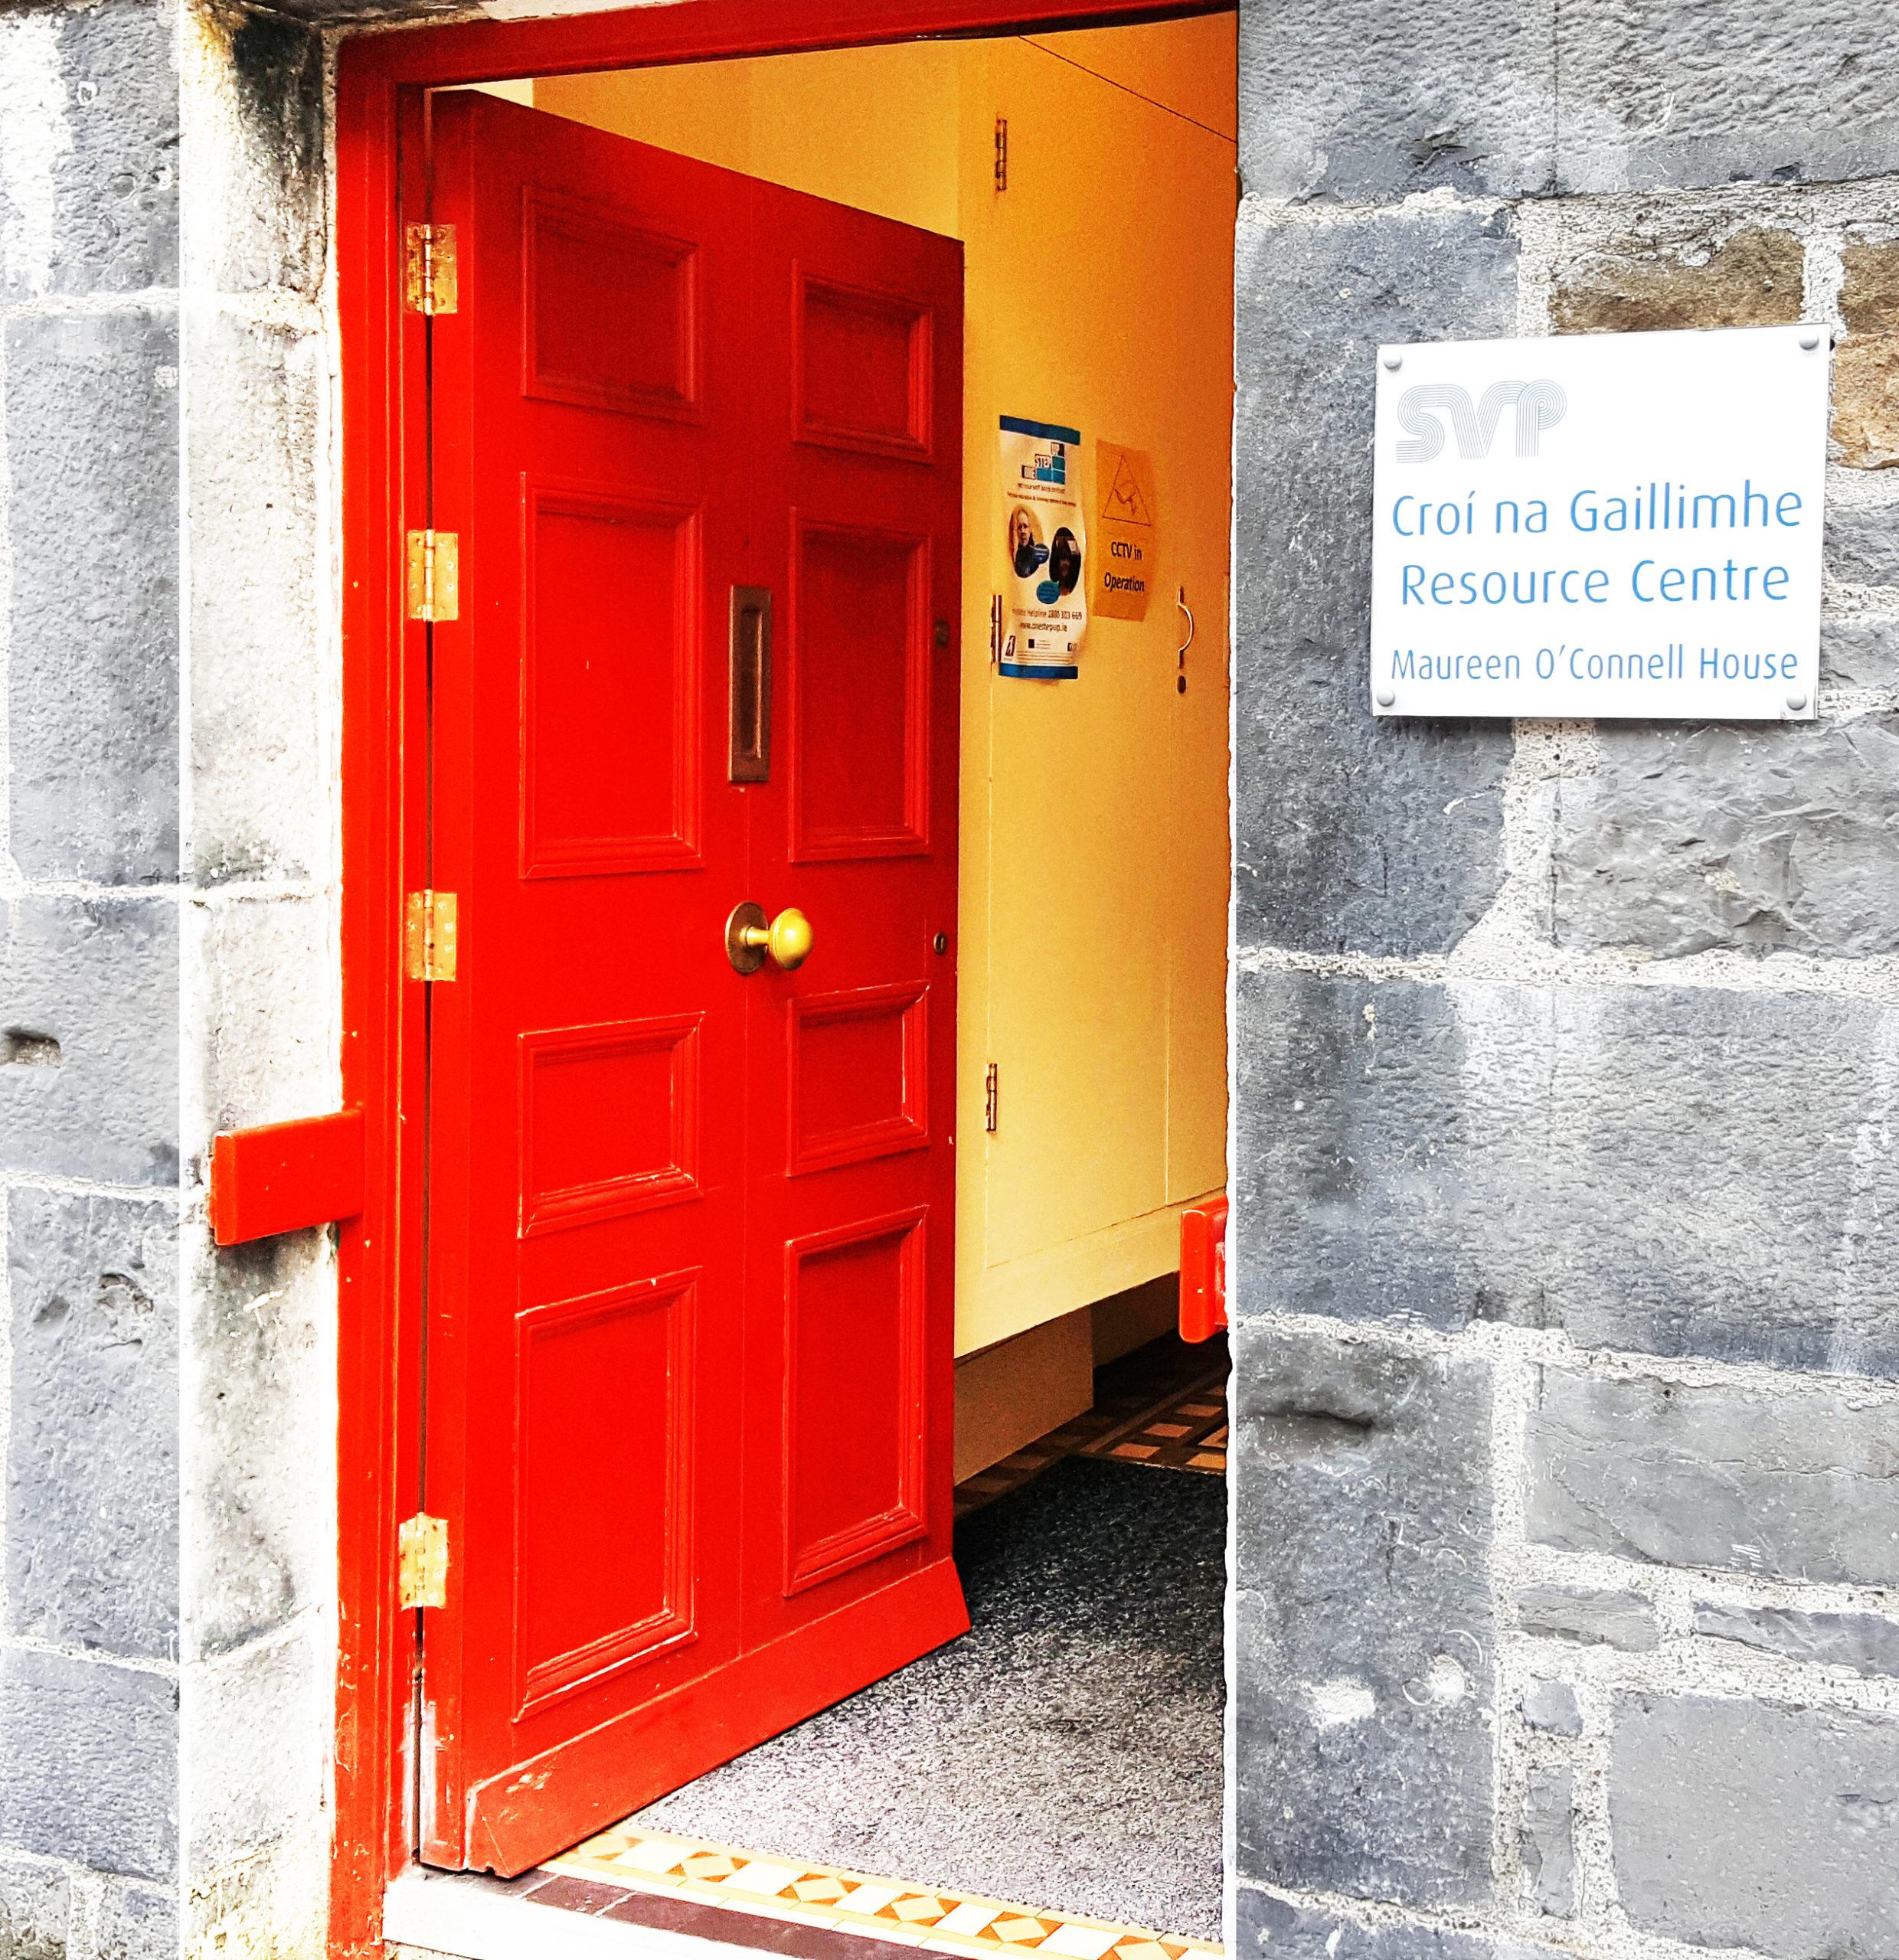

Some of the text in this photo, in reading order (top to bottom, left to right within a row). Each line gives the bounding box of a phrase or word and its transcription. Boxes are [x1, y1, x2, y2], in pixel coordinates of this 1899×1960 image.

[1395, 379, 1567, 462] SVP
[1393, 479, 1802, 536] Croí na Gaillimhe
[1111, 541, 1142, 560] CCTV in
[1104, 572, 1145, 593] Operation
[1403, 559, 1789, 605] Resource Centre
[1392, 650, 1519, 680] Maureen
[1700, 648, 1797, 679] House
